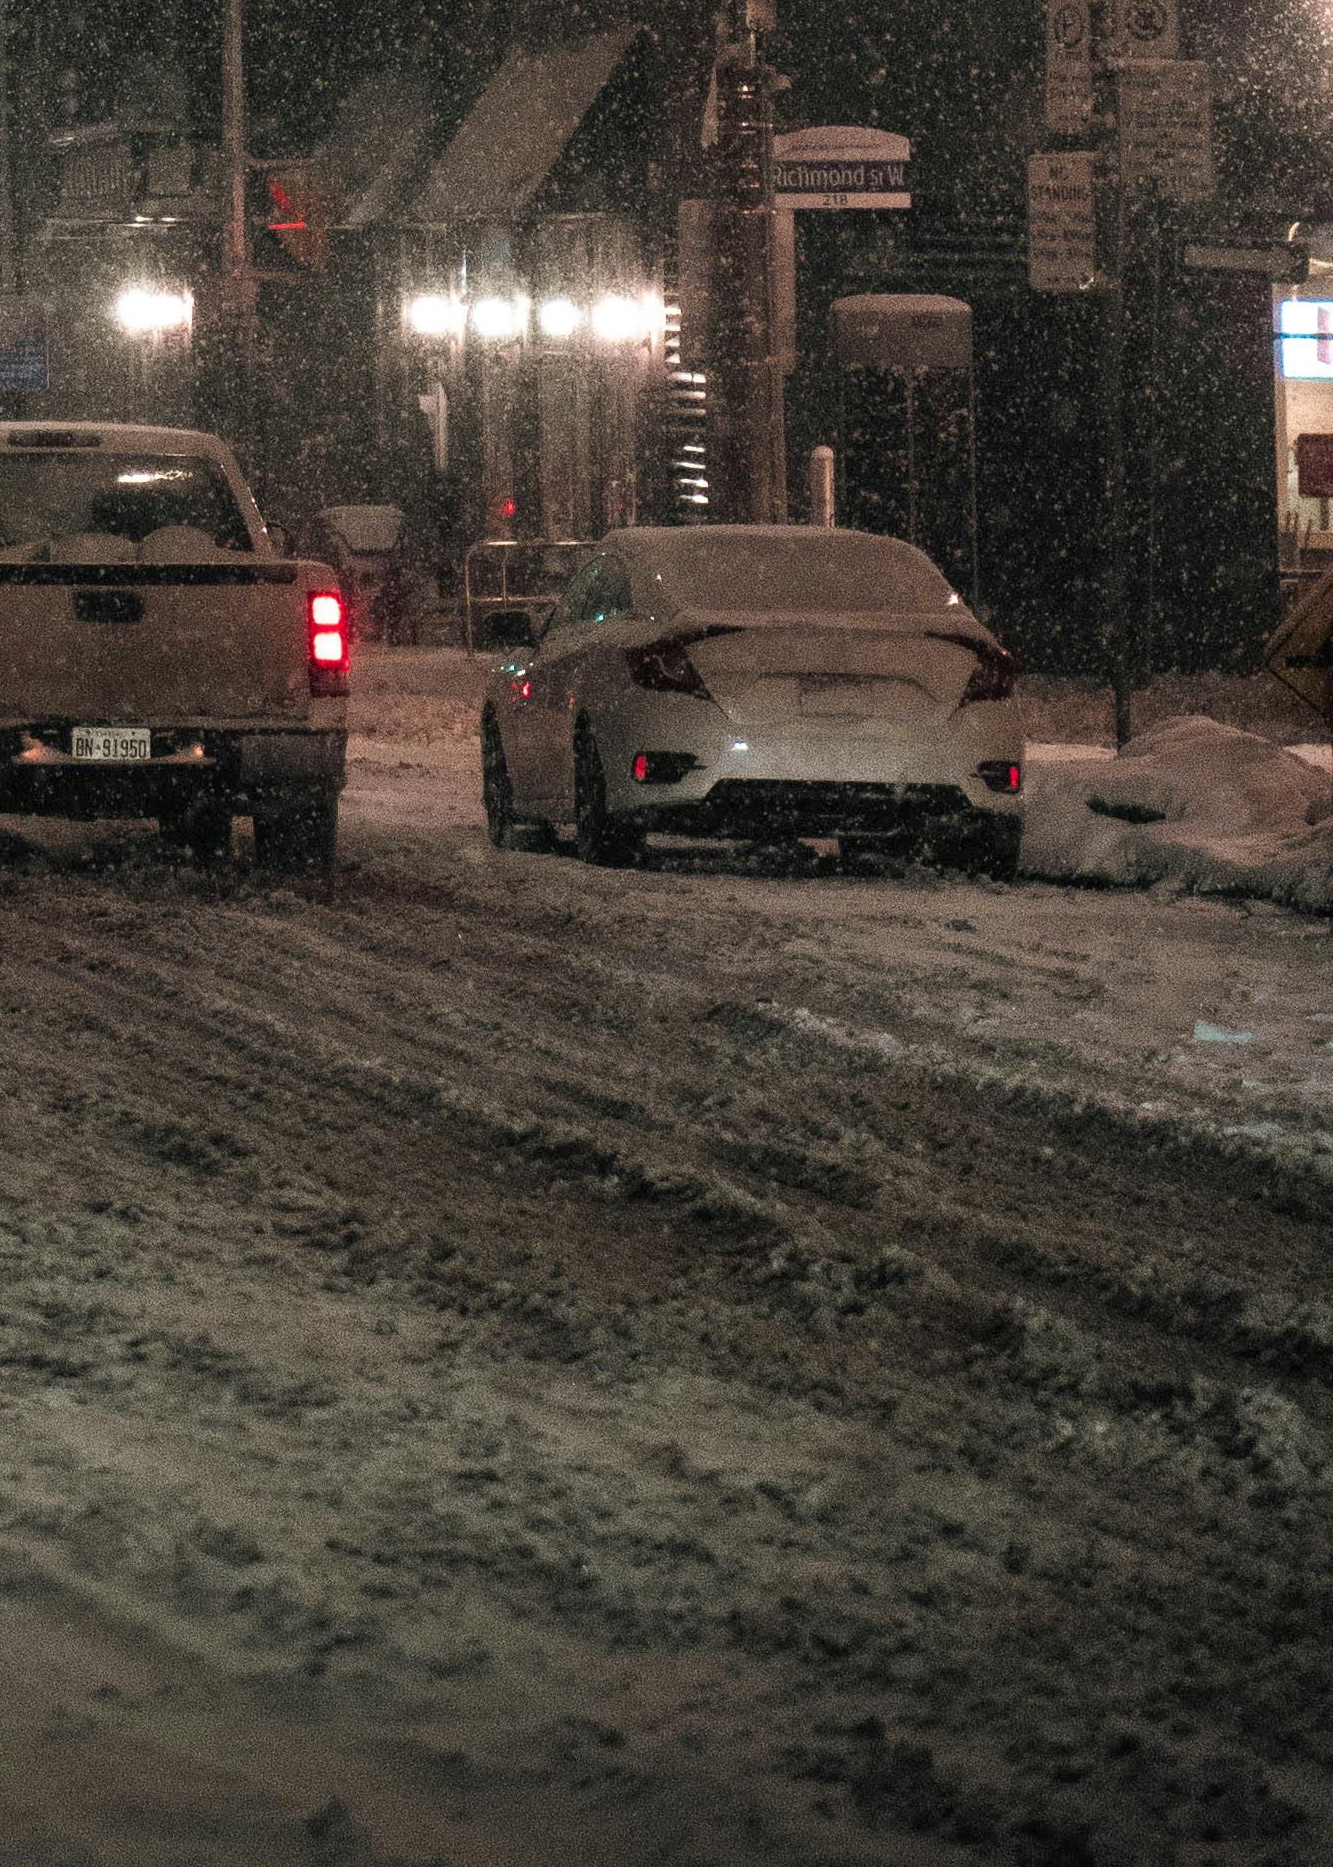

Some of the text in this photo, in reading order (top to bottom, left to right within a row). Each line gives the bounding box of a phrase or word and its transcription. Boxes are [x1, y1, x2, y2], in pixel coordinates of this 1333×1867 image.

[772, 163, 866, 187] Richmond
[885, 164, 906, 186] W
[1030, 185, 1091, 201] STANDING
[76, 737, 147, 758] BN 91950
